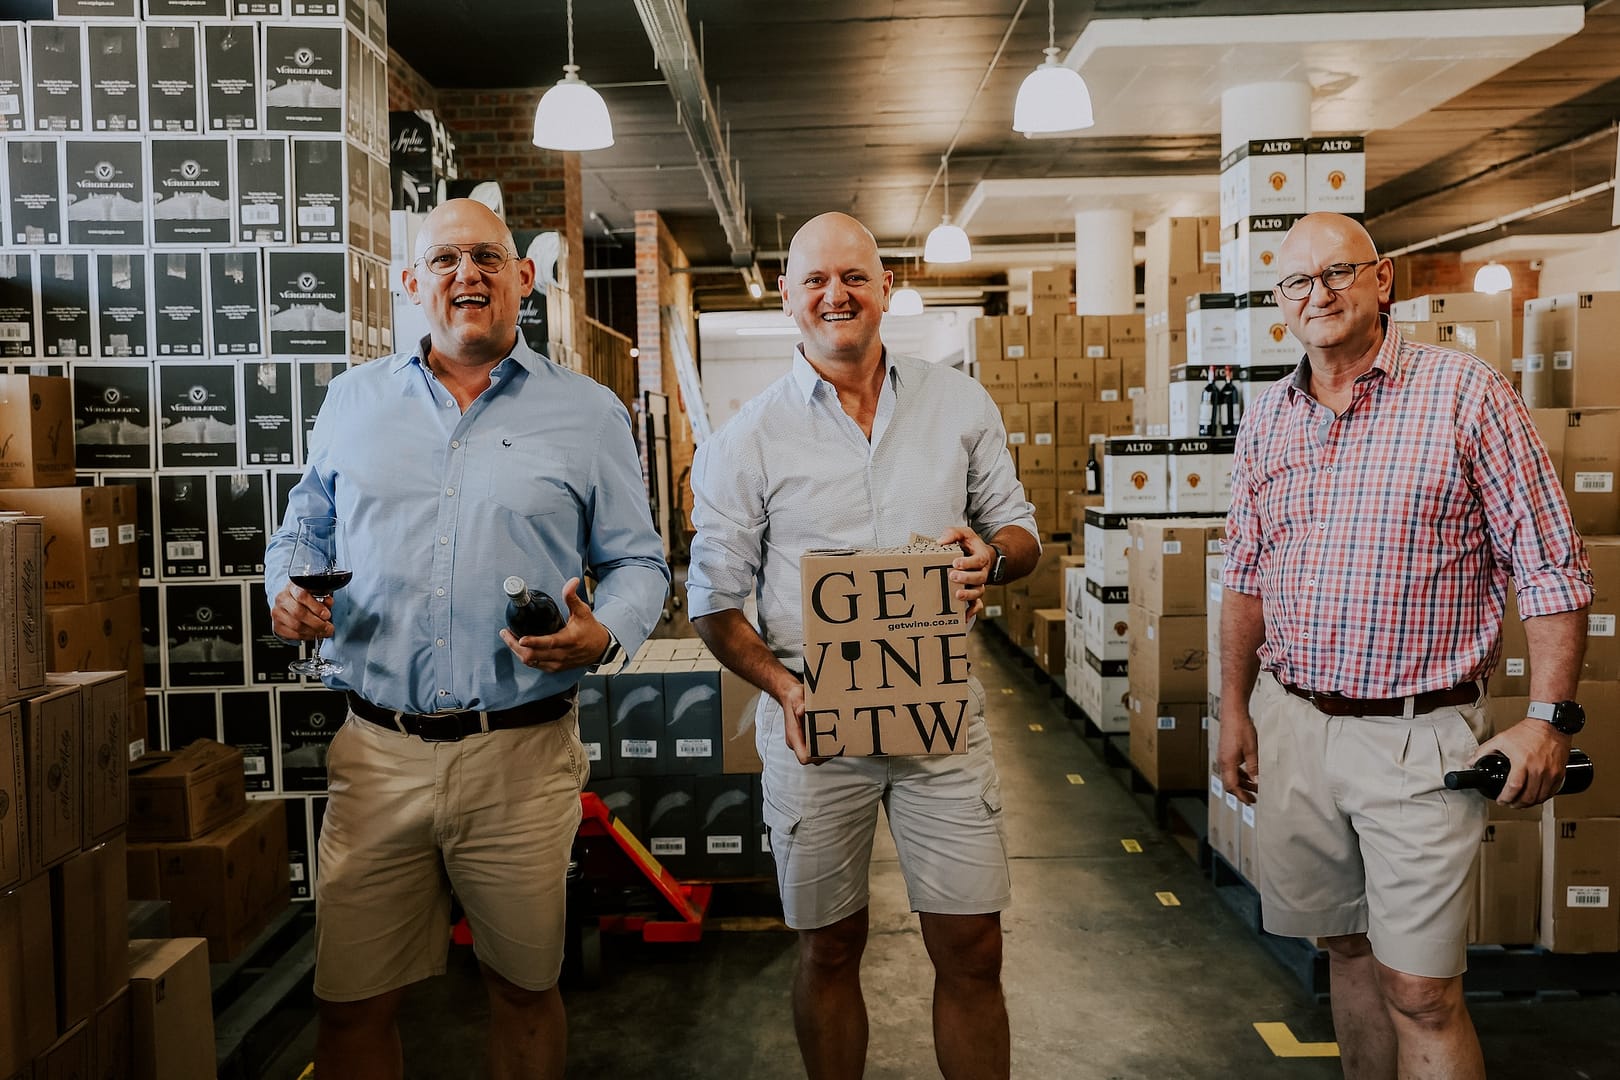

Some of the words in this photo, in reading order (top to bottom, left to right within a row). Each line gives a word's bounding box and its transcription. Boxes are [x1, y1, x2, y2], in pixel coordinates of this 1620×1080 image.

[1262, 142, 1291, 152] ALTO
[1322, 140, 1352, 151] ALTO
[1253, 219, 1282, 229] ALTO
[1125, 443, 1153, 452] ALTO
[1180, 442, 1208, 451] ALTO
[811, 564, 956, 624] GET
[888, 618, 959, 632] getwine.co.za
[805, 700, 968, 758] ETW
